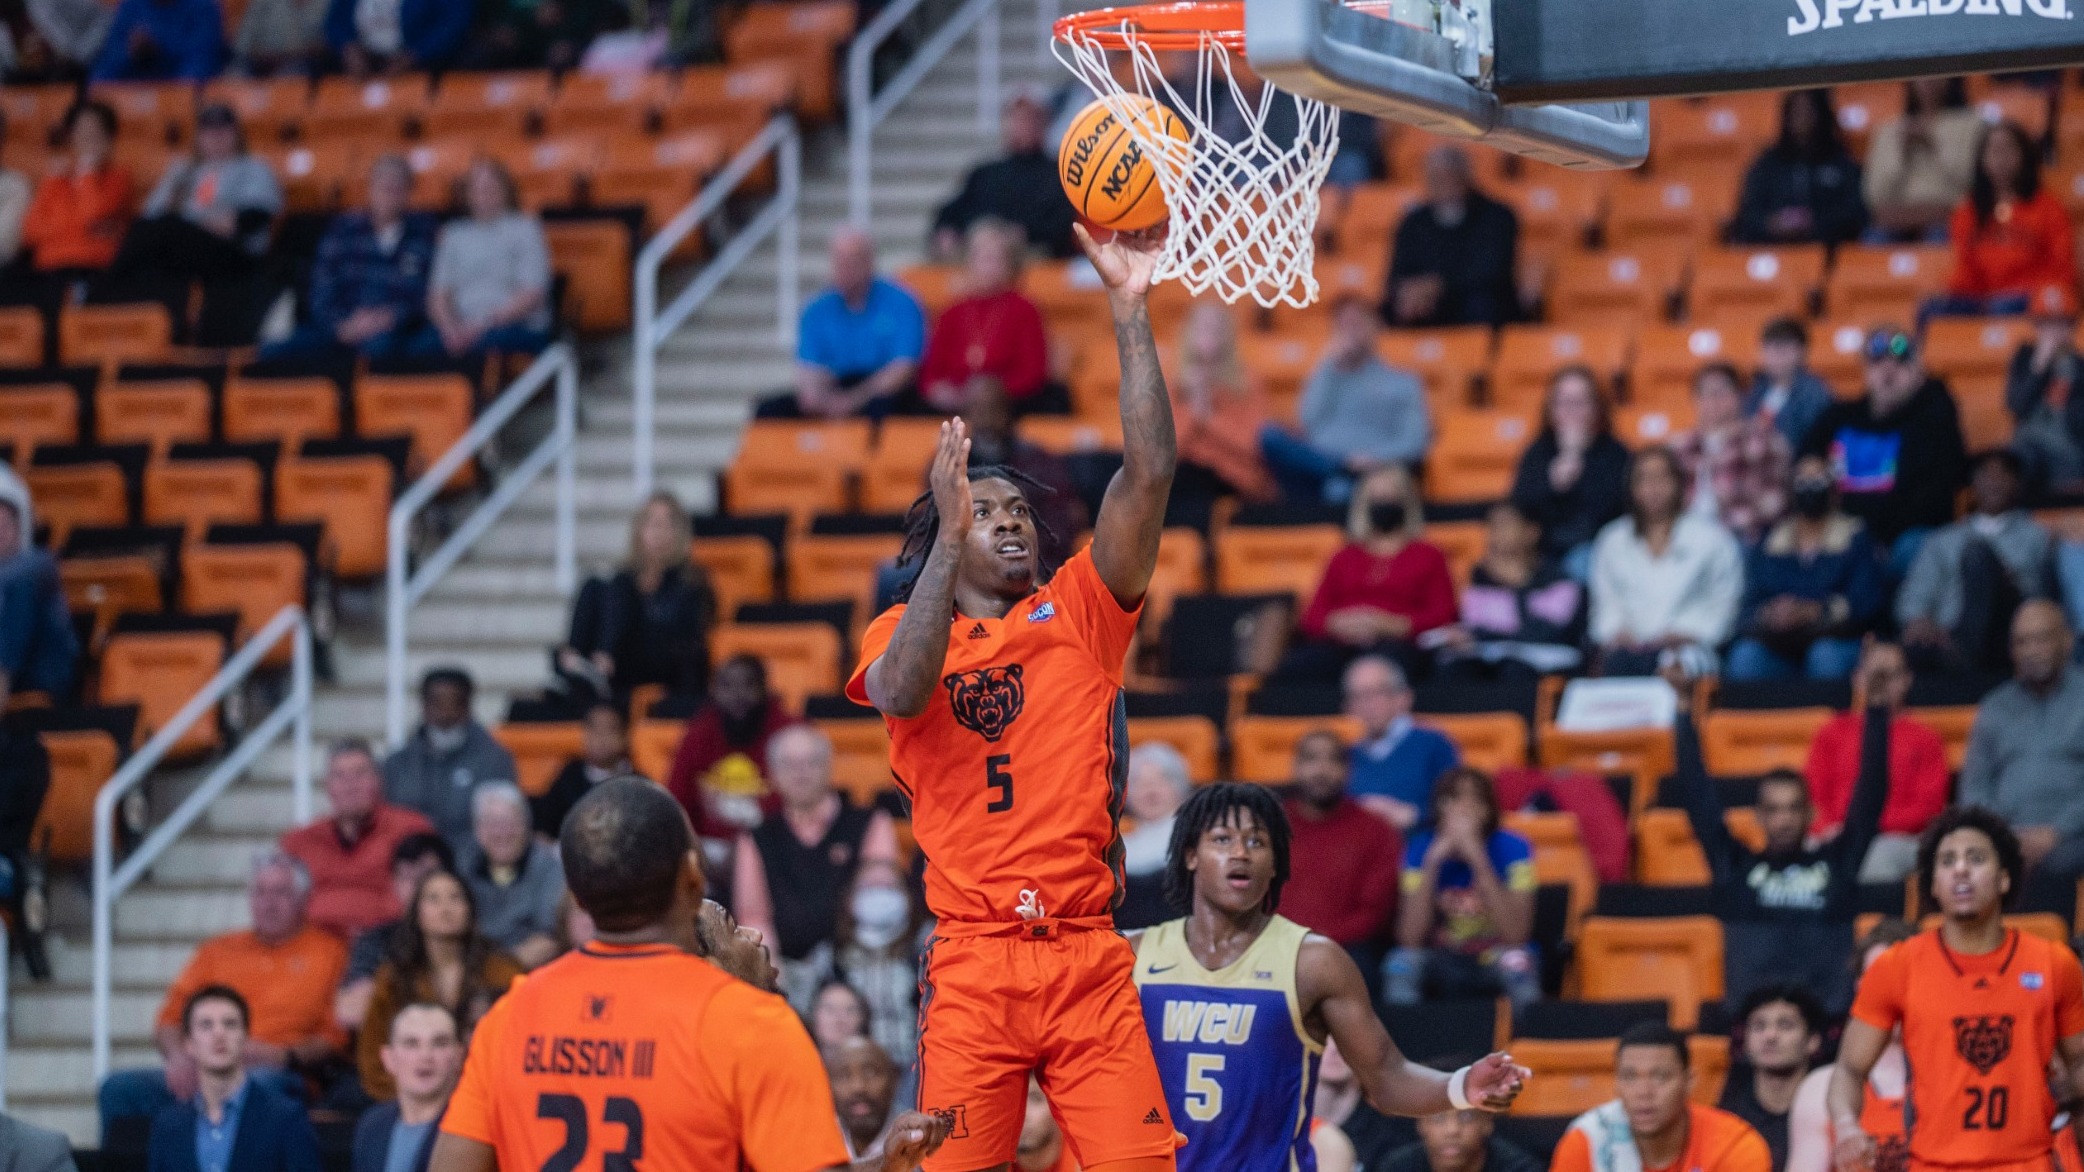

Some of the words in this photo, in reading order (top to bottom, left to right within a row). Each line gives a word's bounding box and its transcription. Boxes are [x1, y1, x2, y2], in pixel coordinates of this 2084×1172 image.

[986, 753, 1014, 814] 5
[1162, 1000, 1257, 1045] WCU
[524, 1035, 627, 1077] GLISSON
[632, 1040, 655, 1078] III
[1184, 1052, 1226, 1122] 5
[1962, 1086, 2009, 1130] 20
[536, 1091, 645, 1172] 23
